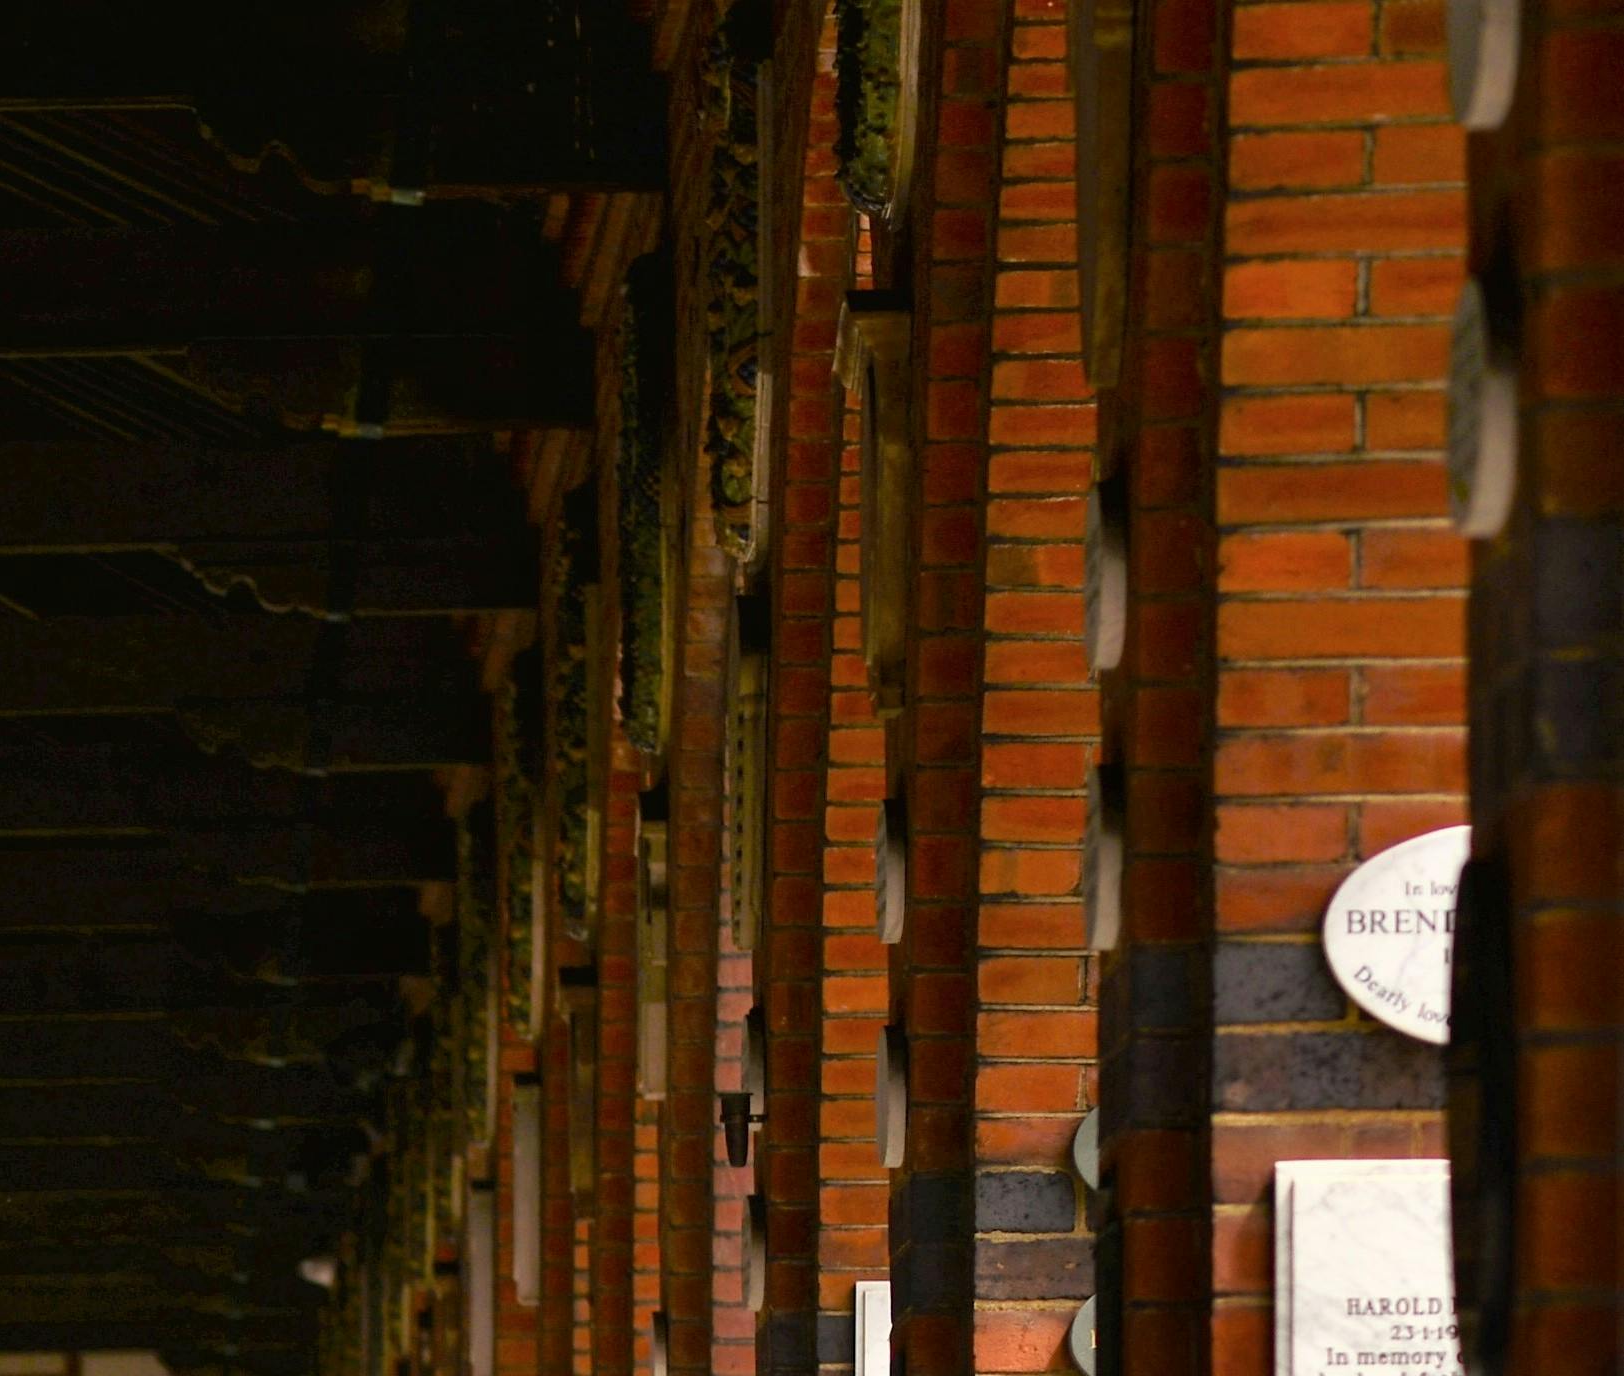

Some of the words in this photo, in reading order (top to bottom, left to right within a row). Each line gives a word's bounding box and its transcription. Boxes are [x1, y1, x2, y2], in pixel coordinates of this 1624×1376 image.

[1430, 881, 1458, 896] lov
[1354, 964, 1412, 1013] Dearly
[1417, 1003, 1451, 1024] lov
[1347, 1297, 1443, 1316] HAROLD
[1326, 1347, 1349, 1366] In
[1356, 1350, 1447, 1369] memory
